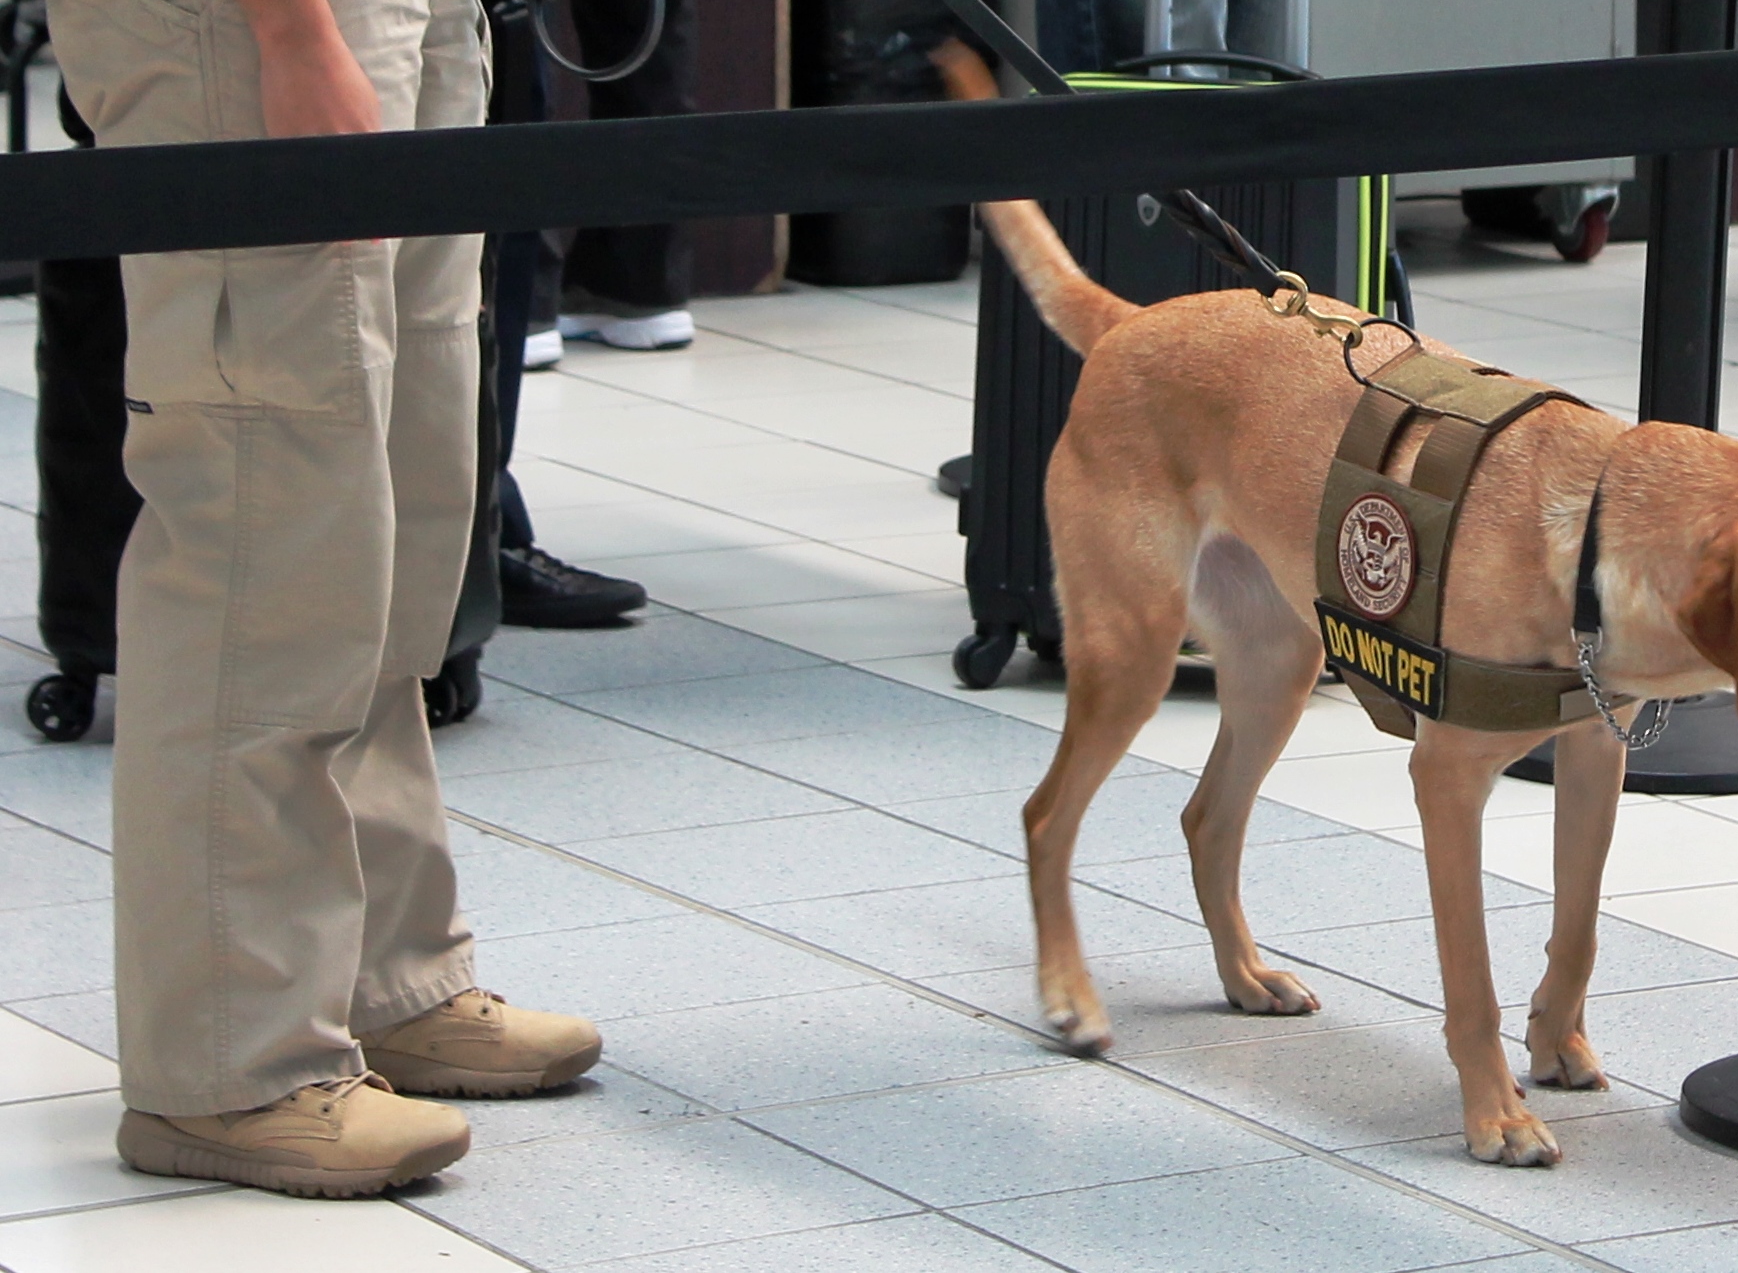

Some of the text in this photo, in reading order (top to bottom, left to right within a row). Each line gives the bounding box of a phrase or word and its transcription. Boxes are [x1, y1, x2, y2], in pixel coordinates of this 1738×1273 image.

[1340, 549, 1407, 611] HOMELAND SECURITY
[1324, 615, 1436, 707] DO NOT PET
